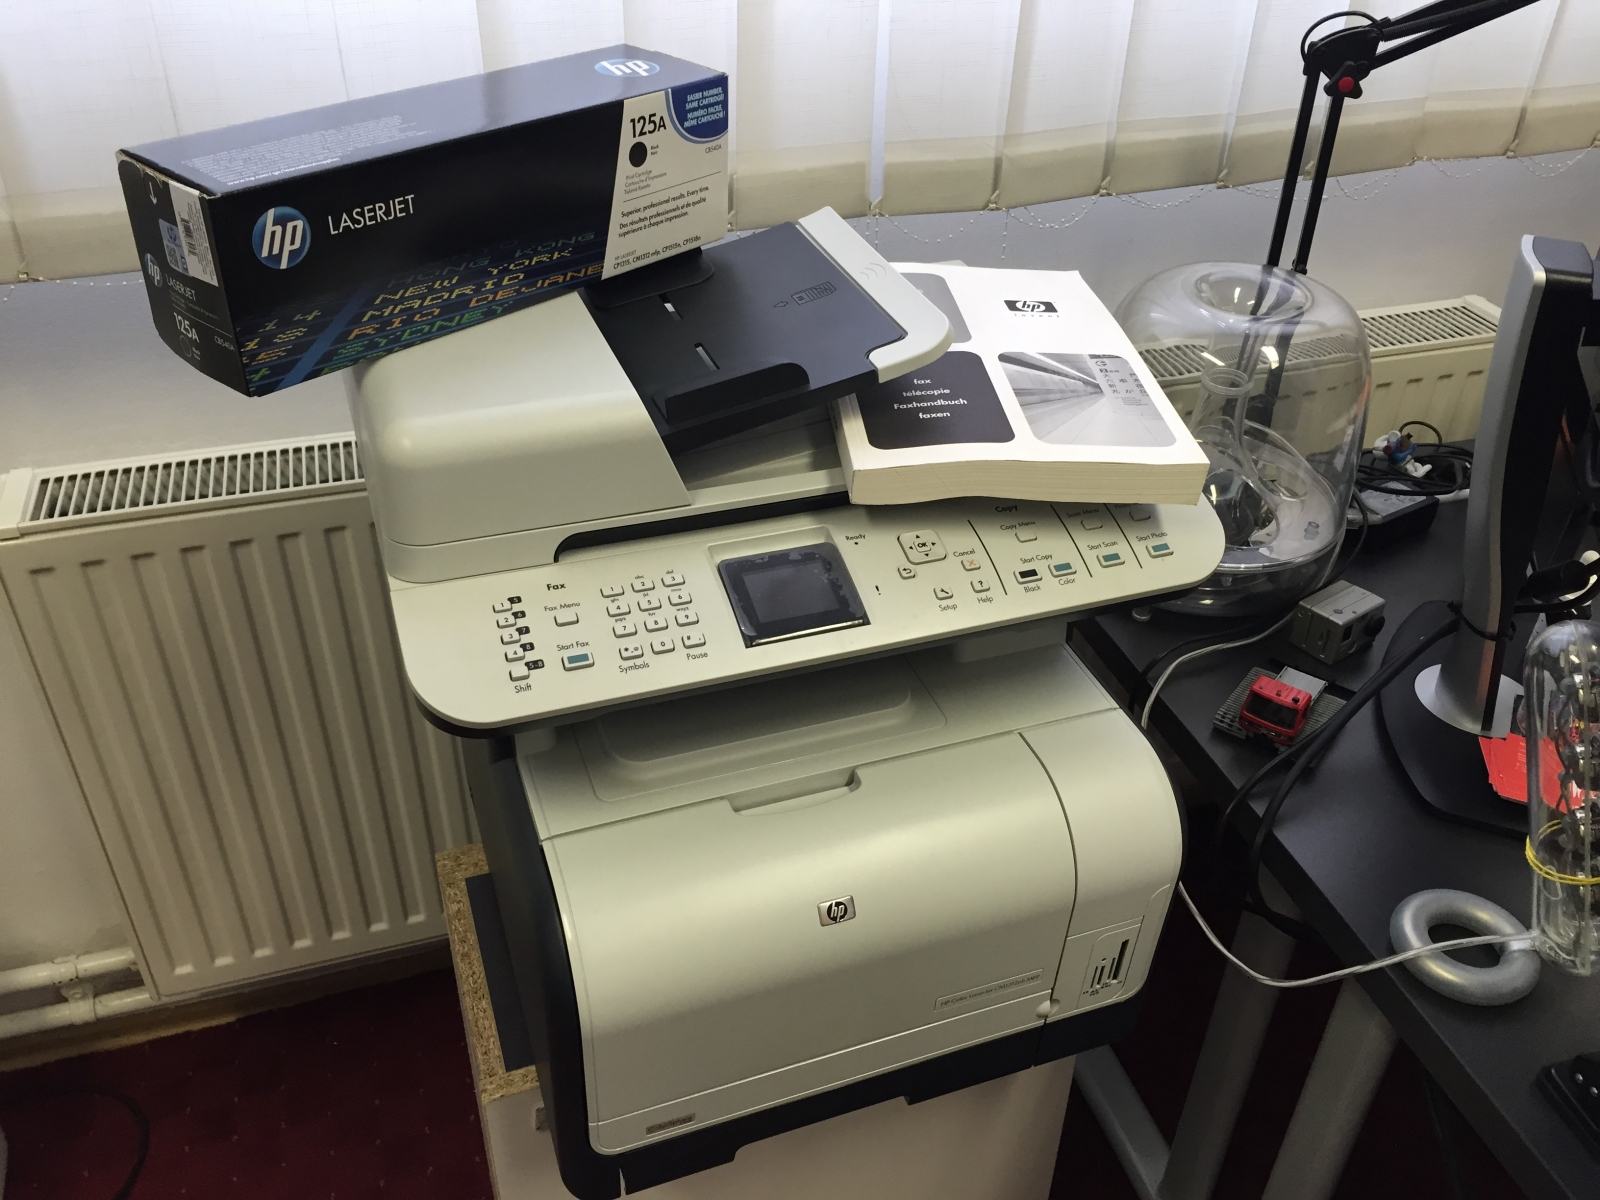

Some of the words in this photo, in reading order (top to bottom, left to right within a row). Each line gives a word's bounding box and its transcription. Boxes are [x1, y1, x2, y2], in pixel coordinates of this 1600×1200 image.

[601, 60, 650, 77] hp
[686, 101, 698, 110] SAME
[630, 113, 667, 138] 125A
[642, 196, 670, 213] professional
[686, 189, 698, 198] Every
[328, 195, 415, 236] LASERJET
[620, 222, 628, 230] Des
[260, 207, 304, 270] hp
[147, 253, 161, 287] hp
[374, 275, 460, 305] NEW
[487, 247, 573, 276] YORK
[361, 272, 526, 323] MADRID
[173, 311, 200, 344] 125A
[902, 386, 950, 397] télécopie
[894, 398, 968, 410] Faxhandbuch
[918, 410, 951, 420] faxen
[1000, 522, 1017, 531] Copy
[845, 533, 866, 542] Ready
[1136, 534, 1150, 542] Start
[1087, 543, 1102, 551] Start
[1102, 540, 1118, 548] Scan
[953, 548, 976, 558] Cancel
[1020, 556, 1035, 564] Start
[1036, 553, 1053, 563] Copy
[546, 582, 566, 592] Fax
[1058, 577, 1076, 586] Color
[1024, 584, 1041, 593] Black
[978, 595, 994, 605] Help
[544, 604, 558, 612] Fax
[559, 601, 581, 610] Menu
[938, 602, 958, 612] Setup
[556, 642, 576, 652] Start
[576, 640, 590, 648] Fax
[686, 651, 709, 661] Pause
[529, 660, 543, 669] 5-8
[618, 661, 650, 674] Symbols
[514, 683, 532, 694] Shift
